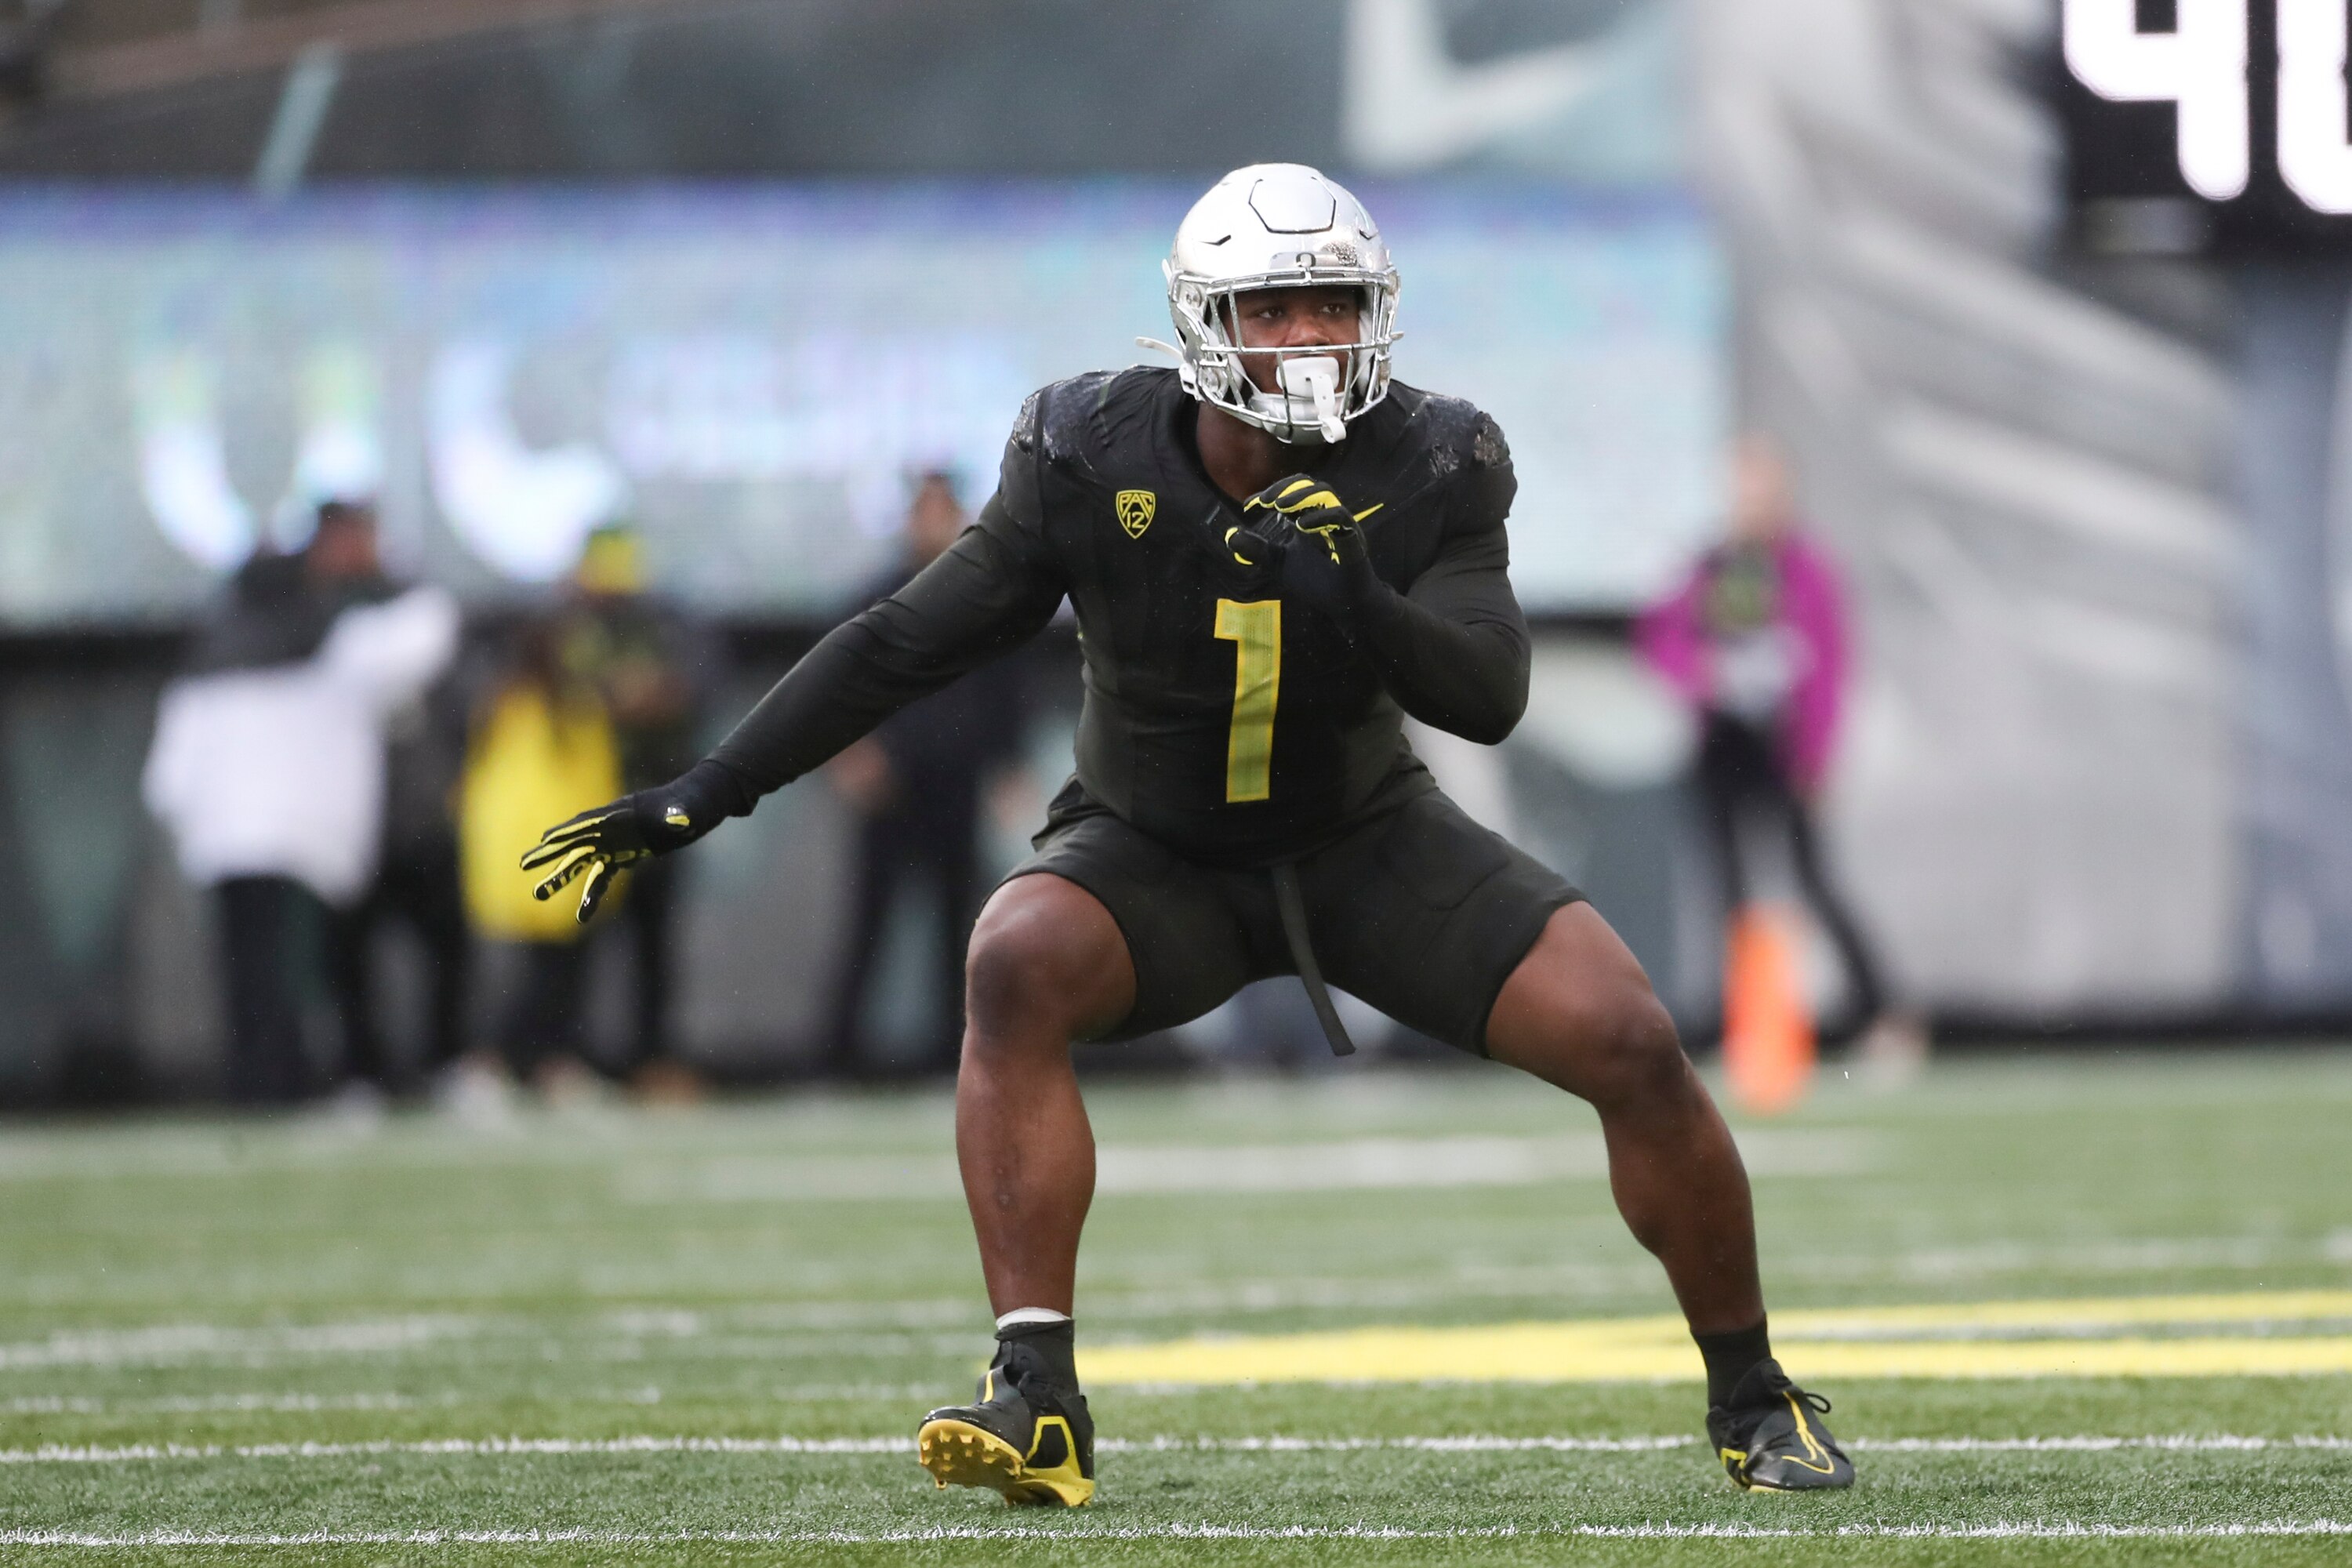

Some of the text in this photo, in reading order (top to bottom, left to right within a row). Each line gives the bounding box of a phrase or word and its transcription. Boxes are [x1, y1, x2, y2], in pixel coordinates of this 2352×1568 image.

[1119, 493, 1152, 519] PAC
[1127, 511, 1145, 528] 12
[1214, 598, 1281, 803] 1
